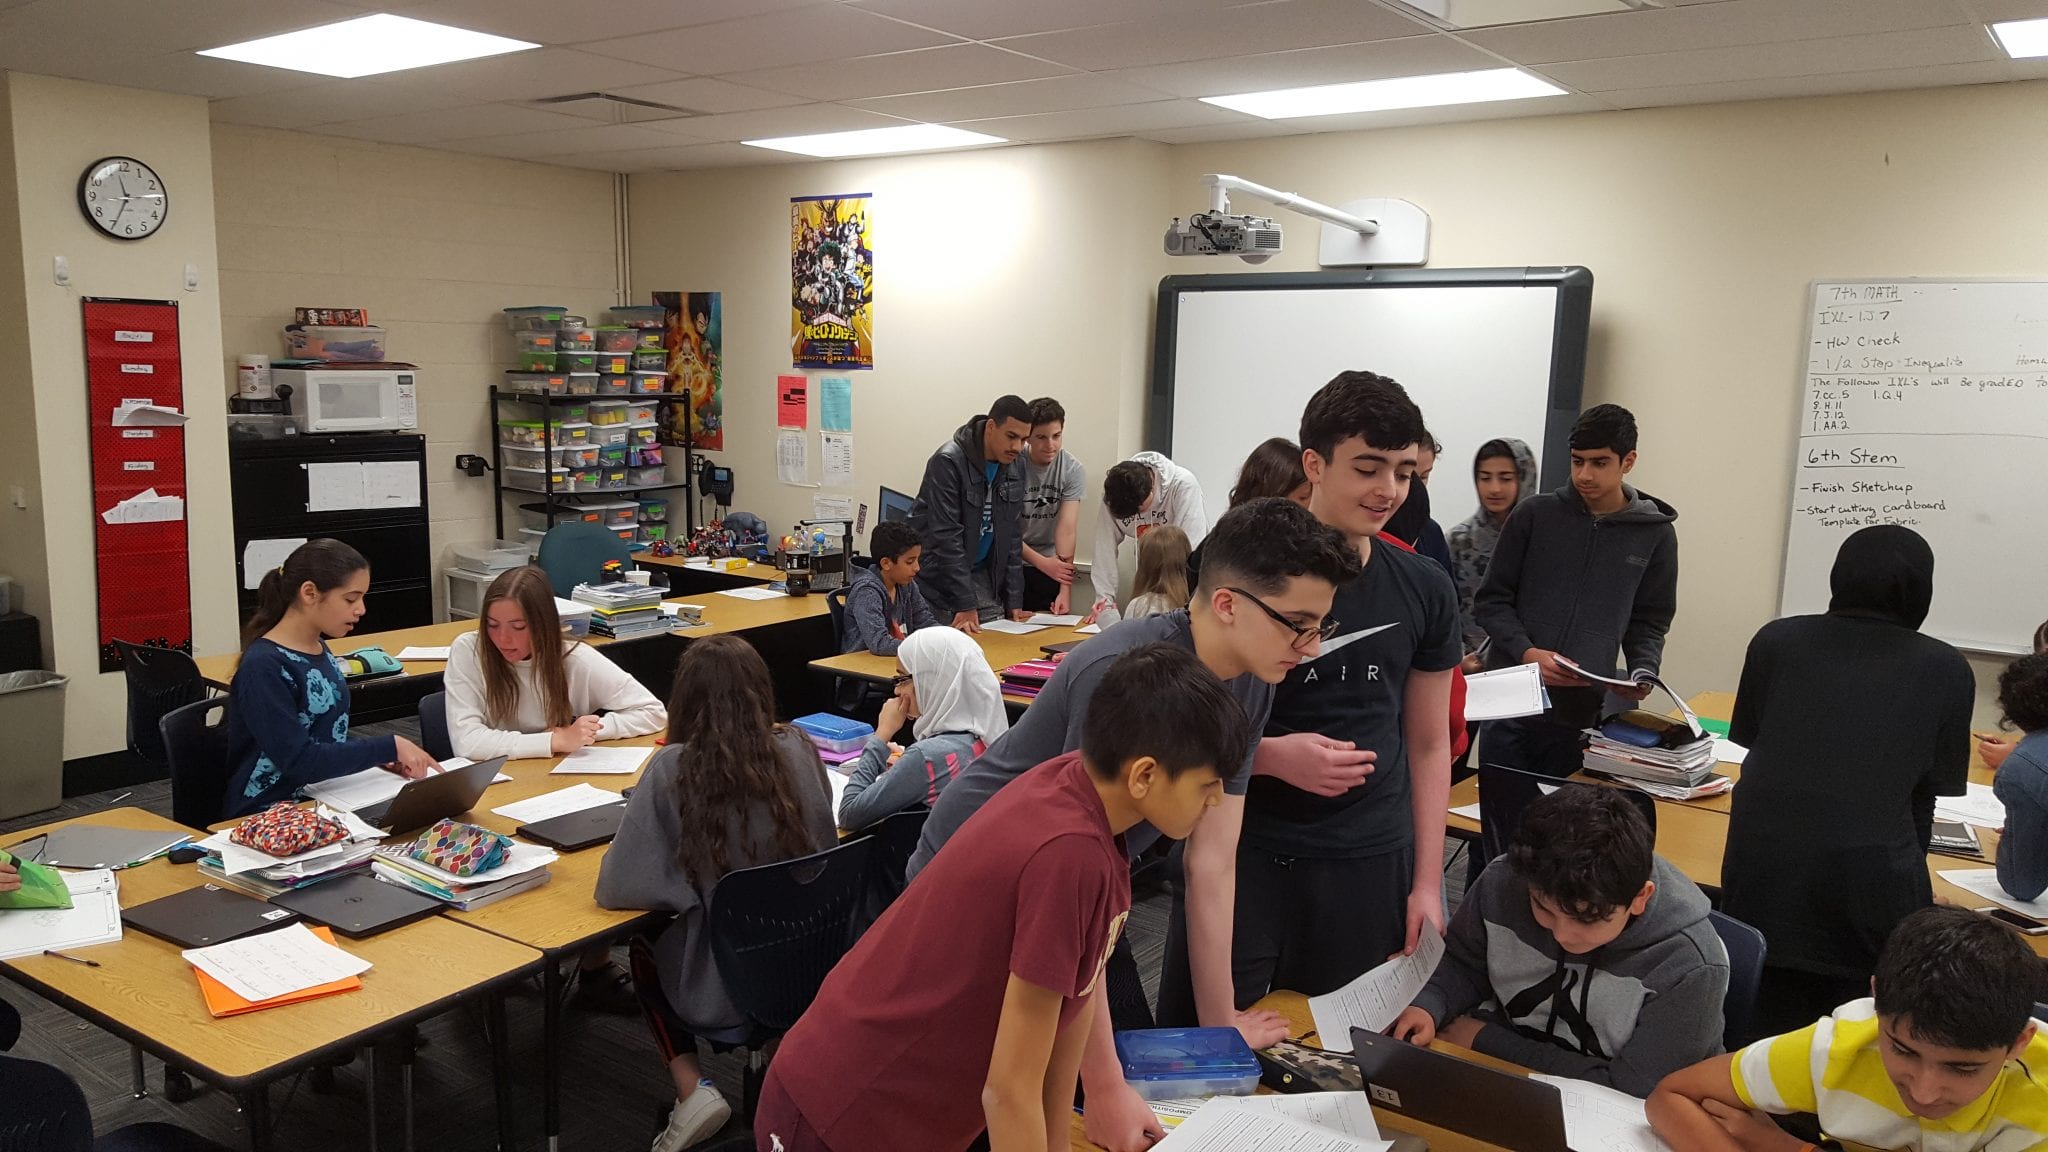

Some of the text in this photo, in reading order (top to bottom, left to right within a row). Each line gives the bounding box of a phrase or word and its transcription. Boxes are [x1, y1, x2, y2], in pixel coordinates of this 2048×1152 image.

[118, 161, 130, 172] 12
[91, 176, 102, 187] 10
[148, 180, 156, 190] 2
[89, 191, 96, 202] 9
[154, 197, 162, 206] 3
[95, 206, 103, 218] 8
[151, 210, 159, 221] 4
[125, 224, 133, 235] 6
[140, 221, 147, 231] 5
[1829, 285, 1899, 301] 7th MATH
[1826, 336, 1850, 349] HW
[1810, 377, 1830, 387] The
[1930, 377, 1950, 386] will
[1807, 447, 1897, 464] 6th Stem
[1811, 481, 1845, 493] Finish
[1851, 481, 1913, 495] Sketchup
[1807, 504, 1836, 515] Start
[1838, 502, 1877, 518] cutting
[1882, 500, 1946, 513] cardboard
[1818, 517, 1861, 528] Template
[1865, 515, 1880, 525] for
[1303, 664, 1380, 684] AIR
